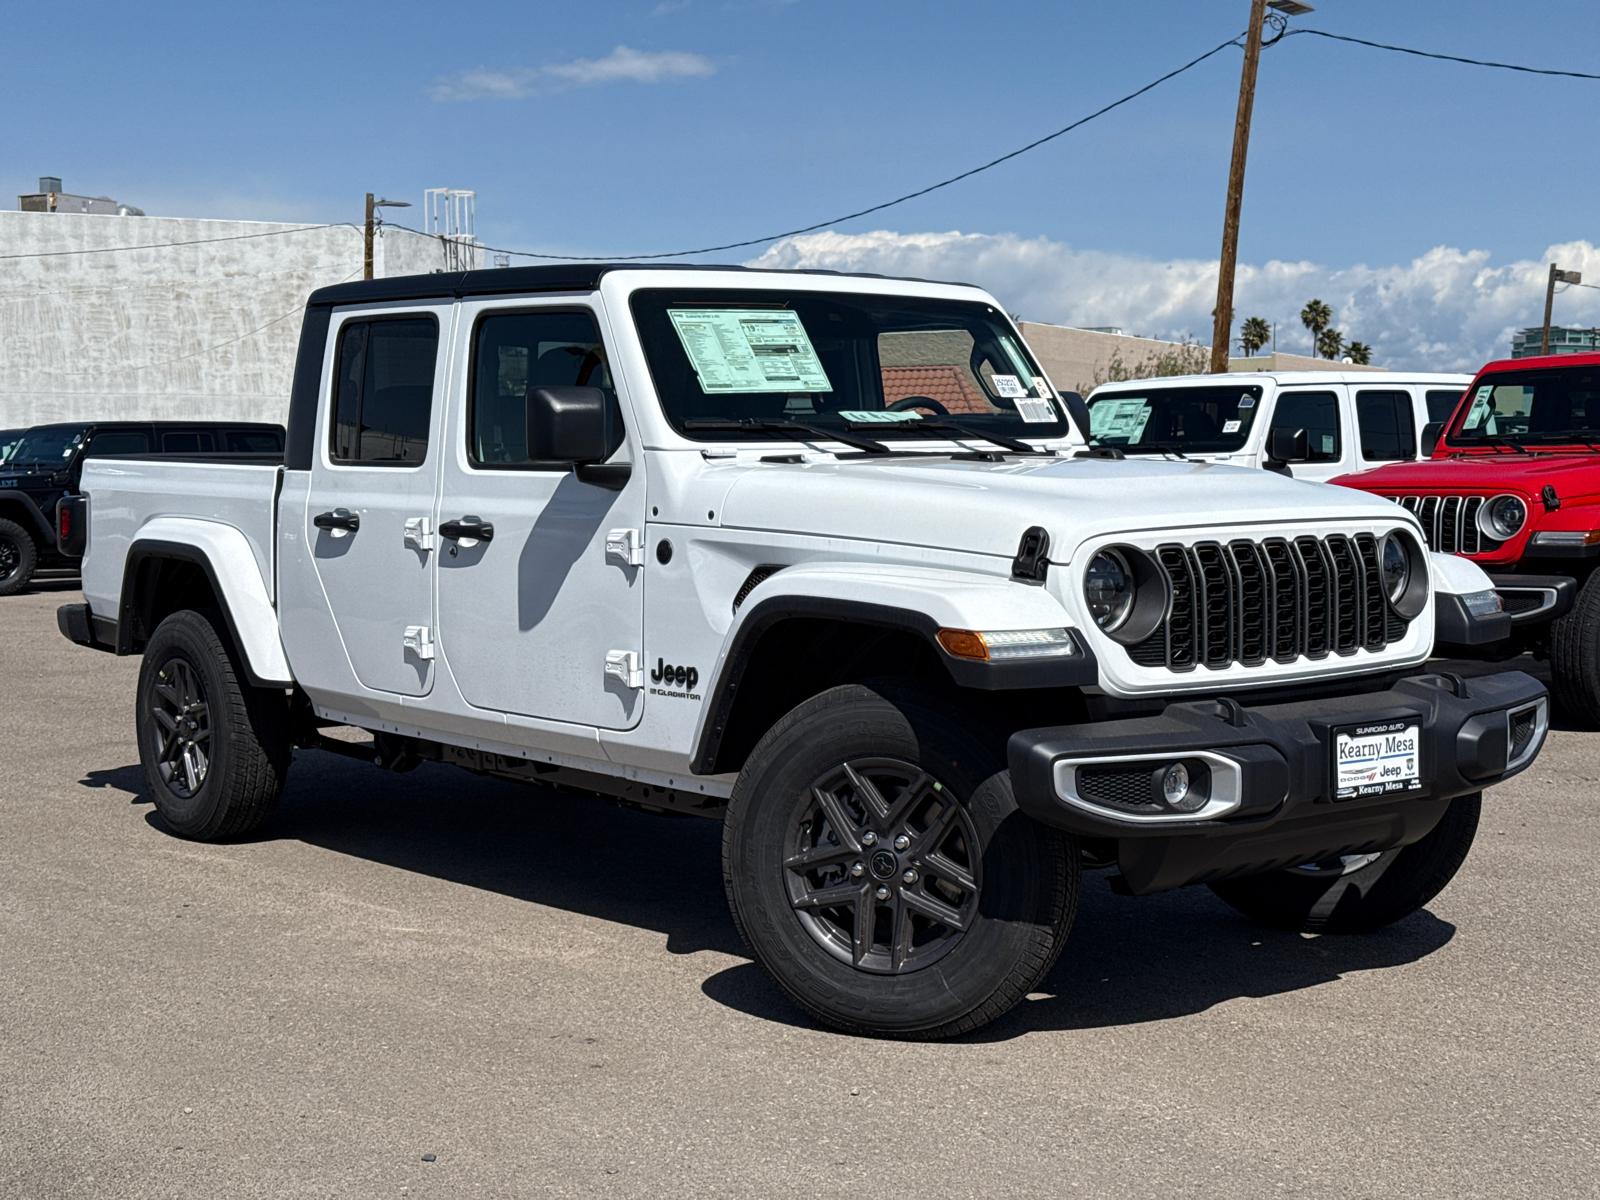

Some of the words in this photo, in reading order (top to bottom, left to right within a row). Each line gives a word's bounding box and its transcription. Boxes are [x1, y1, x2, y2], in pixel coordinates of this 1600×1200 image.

[651, 657, 699, 690] Jeep
[657, 689, 701, 701] GLADIATOR
[1356, 726, 1387, 734] SUNROAD
[1388, 723, 1405, 731] AUTO
[1339, 742, 1382, 761] Kearny
[1385, 736, 1414, 754] Mesa
[1380, 766, 1402, 778] Jeep
[1359, 785, 1384, 794] Kearny
[1385, 782, 1403, 790] Mesa
